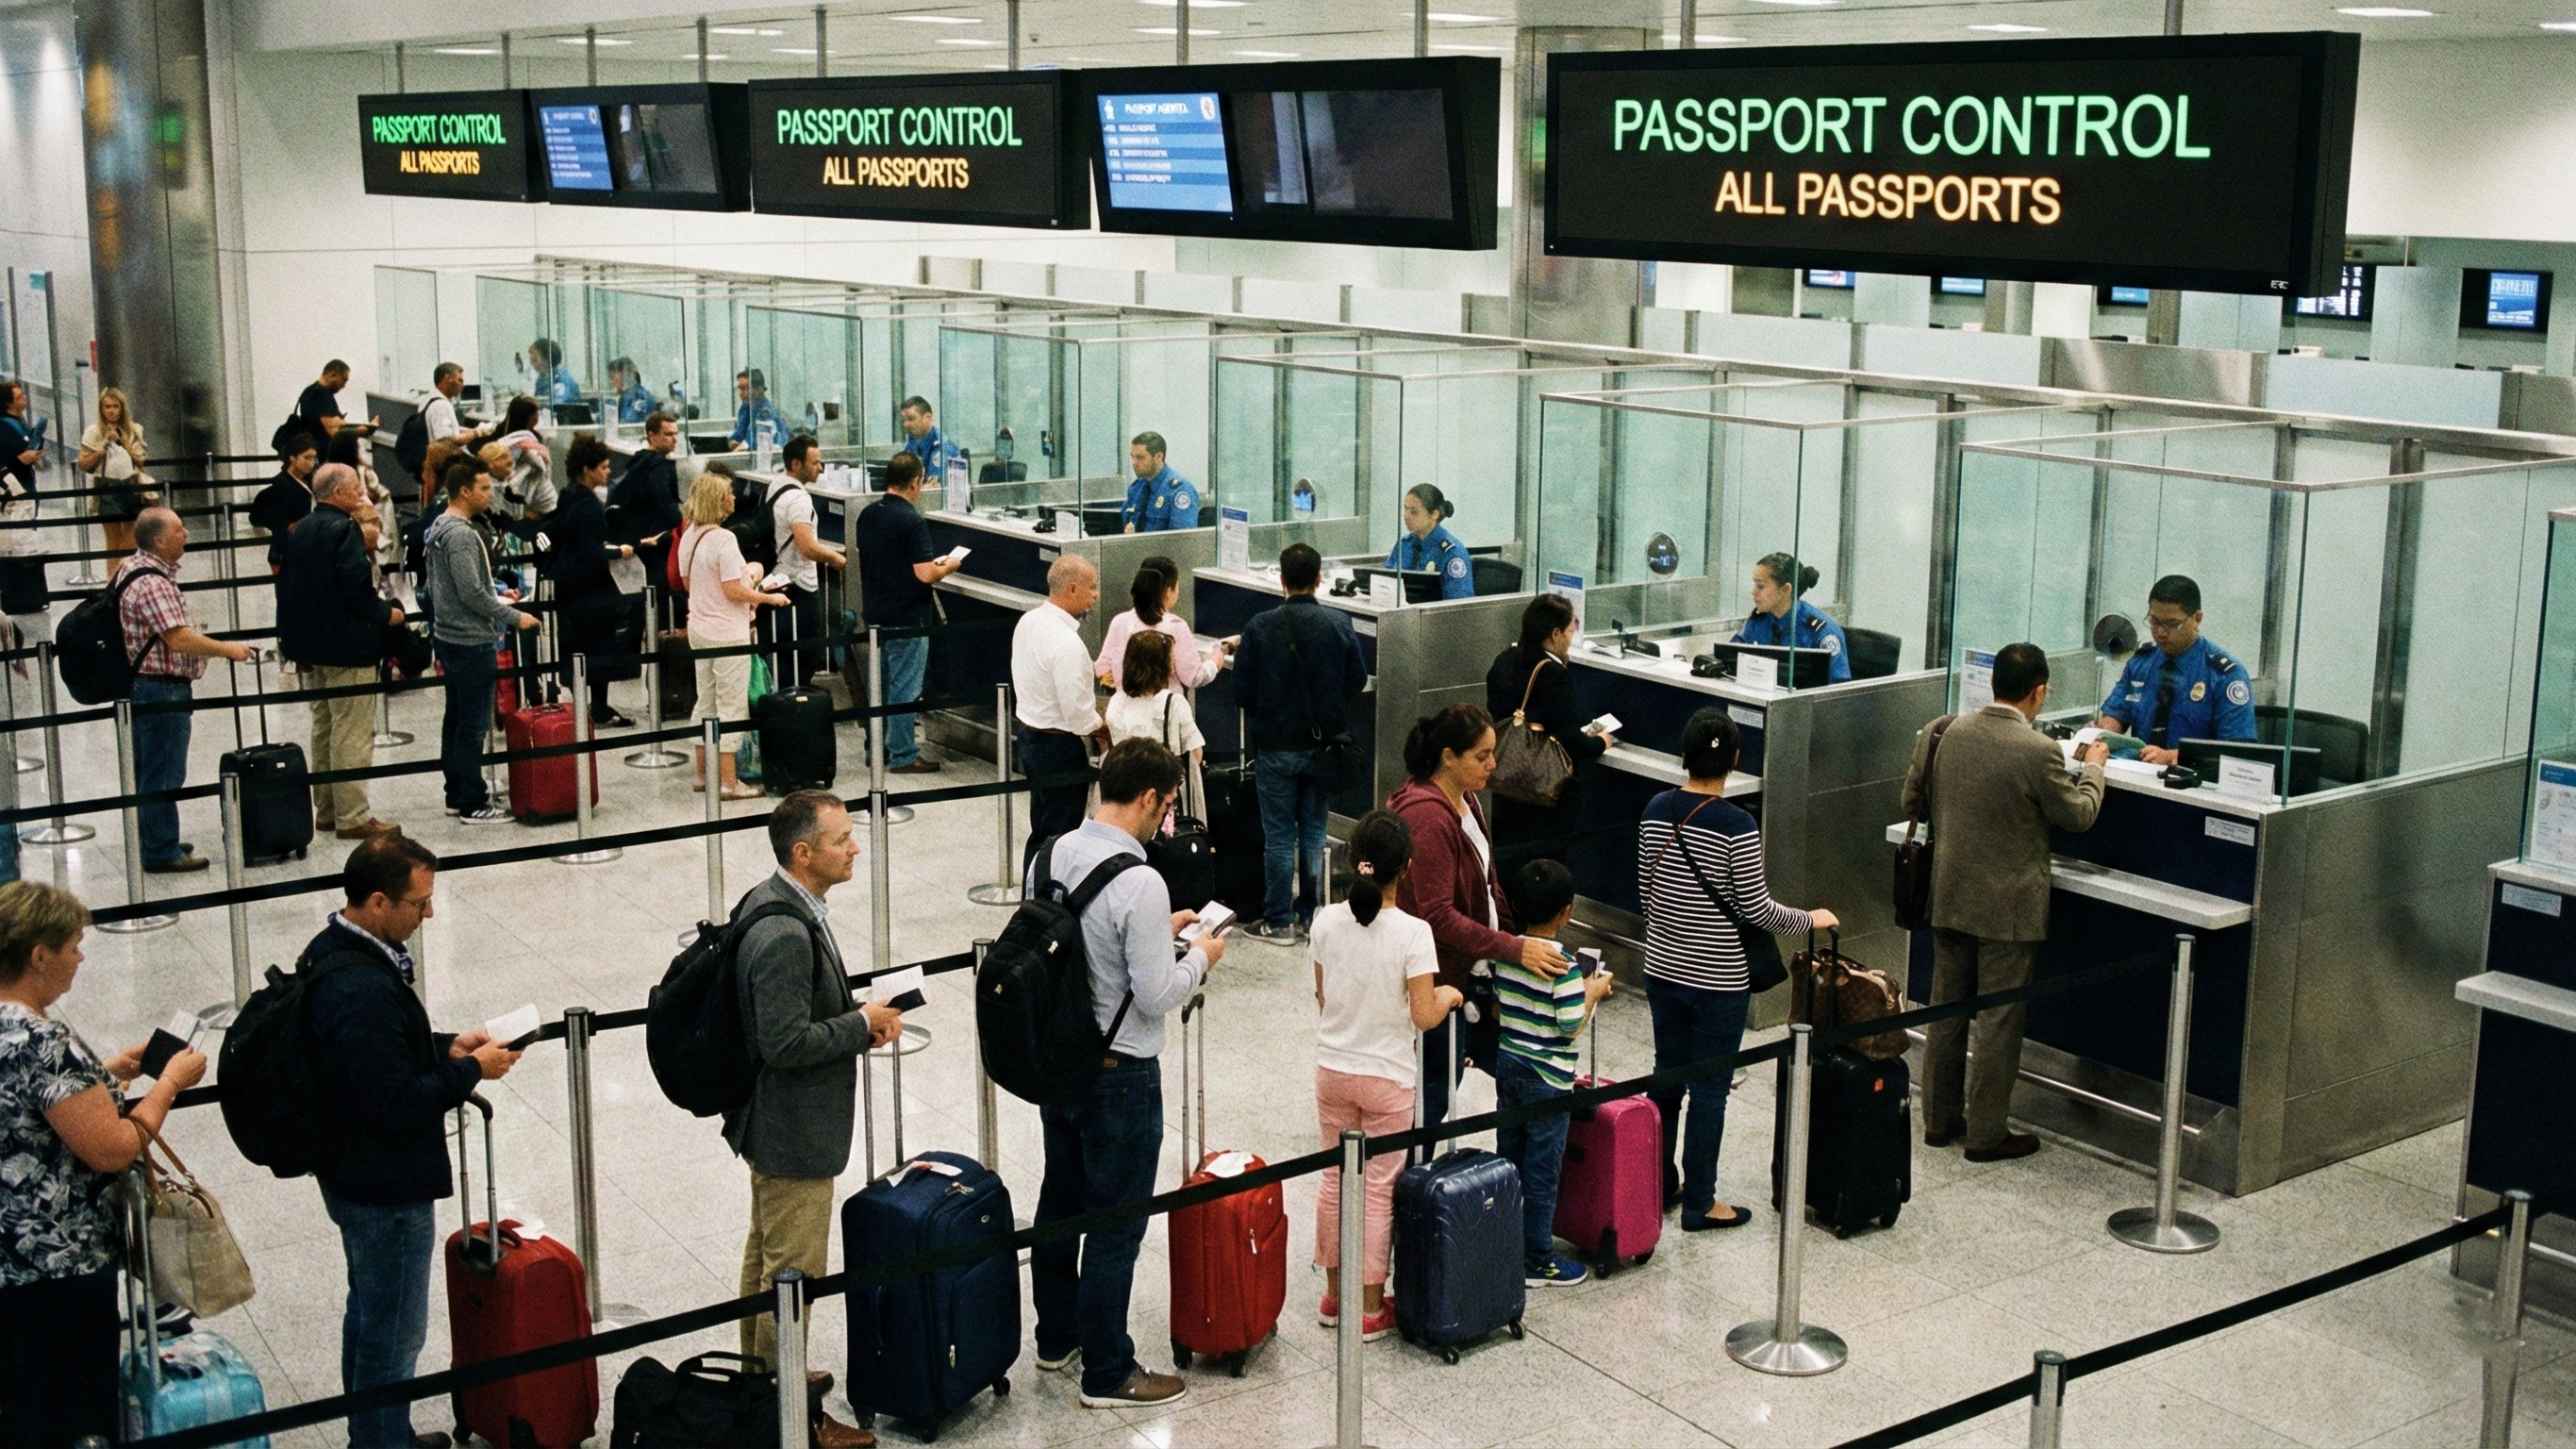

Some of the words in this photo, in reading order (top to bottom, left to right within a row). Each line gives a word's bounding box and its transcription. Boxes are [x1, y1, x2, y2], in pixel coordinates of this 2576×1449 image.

[372, 114, 438, 144] PASSPORT
[439, 113, 507, 145] CONTROL
[776, 108, 894, 146] PASSPORT
[899, 106, 1023, 147] CONTROL
[1614, 97, 1887, 154] PASSPORT
[1902, 93, 2212, 159] CONTROL
[400, 150, 418, 174] ALL
[418, 151, 481, 175] PASSPORTS
[823, 156, 853, 186] ALL
[857, 157, 971, 190] PASSPORTS
[1714, 171, 1787, 215] ALL
[1797, 173, 2062, 225] PASSPORTS
